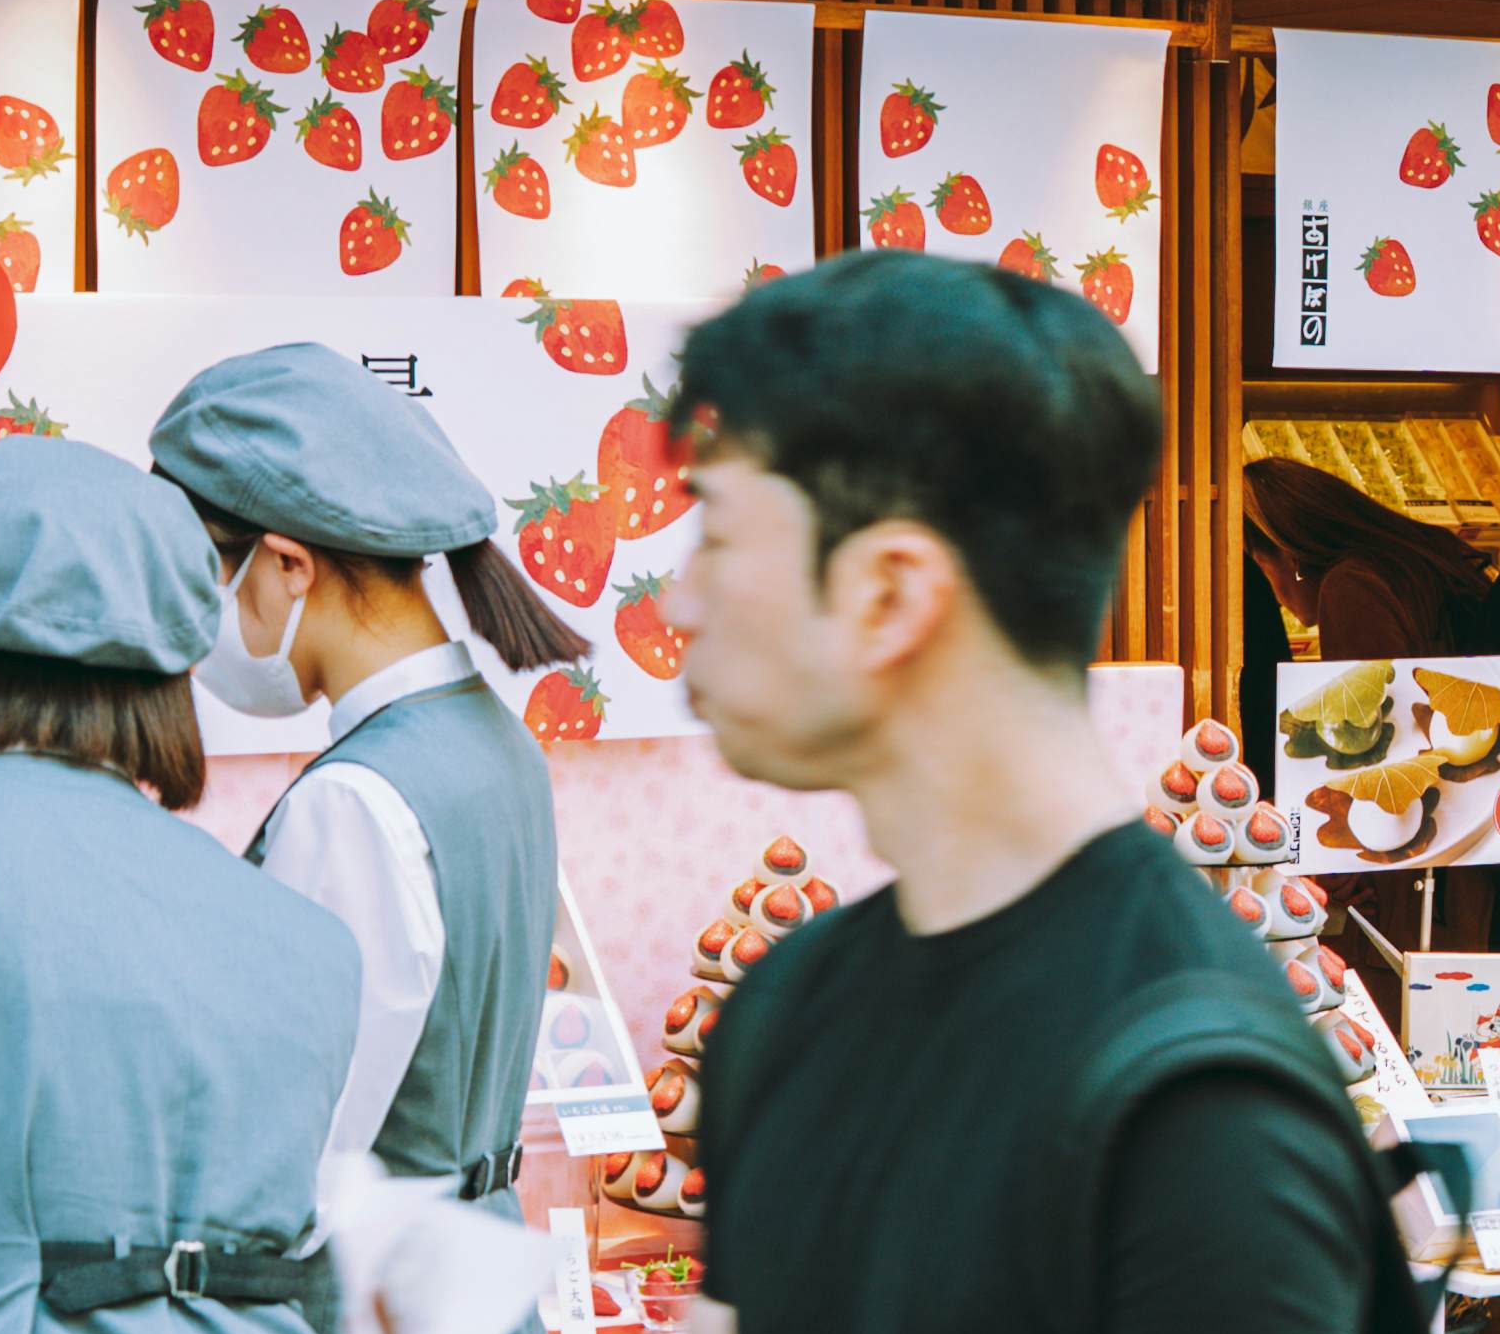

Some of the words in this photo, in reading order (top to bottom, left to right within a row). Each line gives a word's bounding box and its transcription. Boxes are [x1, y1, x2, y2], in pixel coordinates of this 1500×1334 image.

[1303, 199, 1329, 212] 銀座
[1302, 216, 1328, 345] あけぼの
